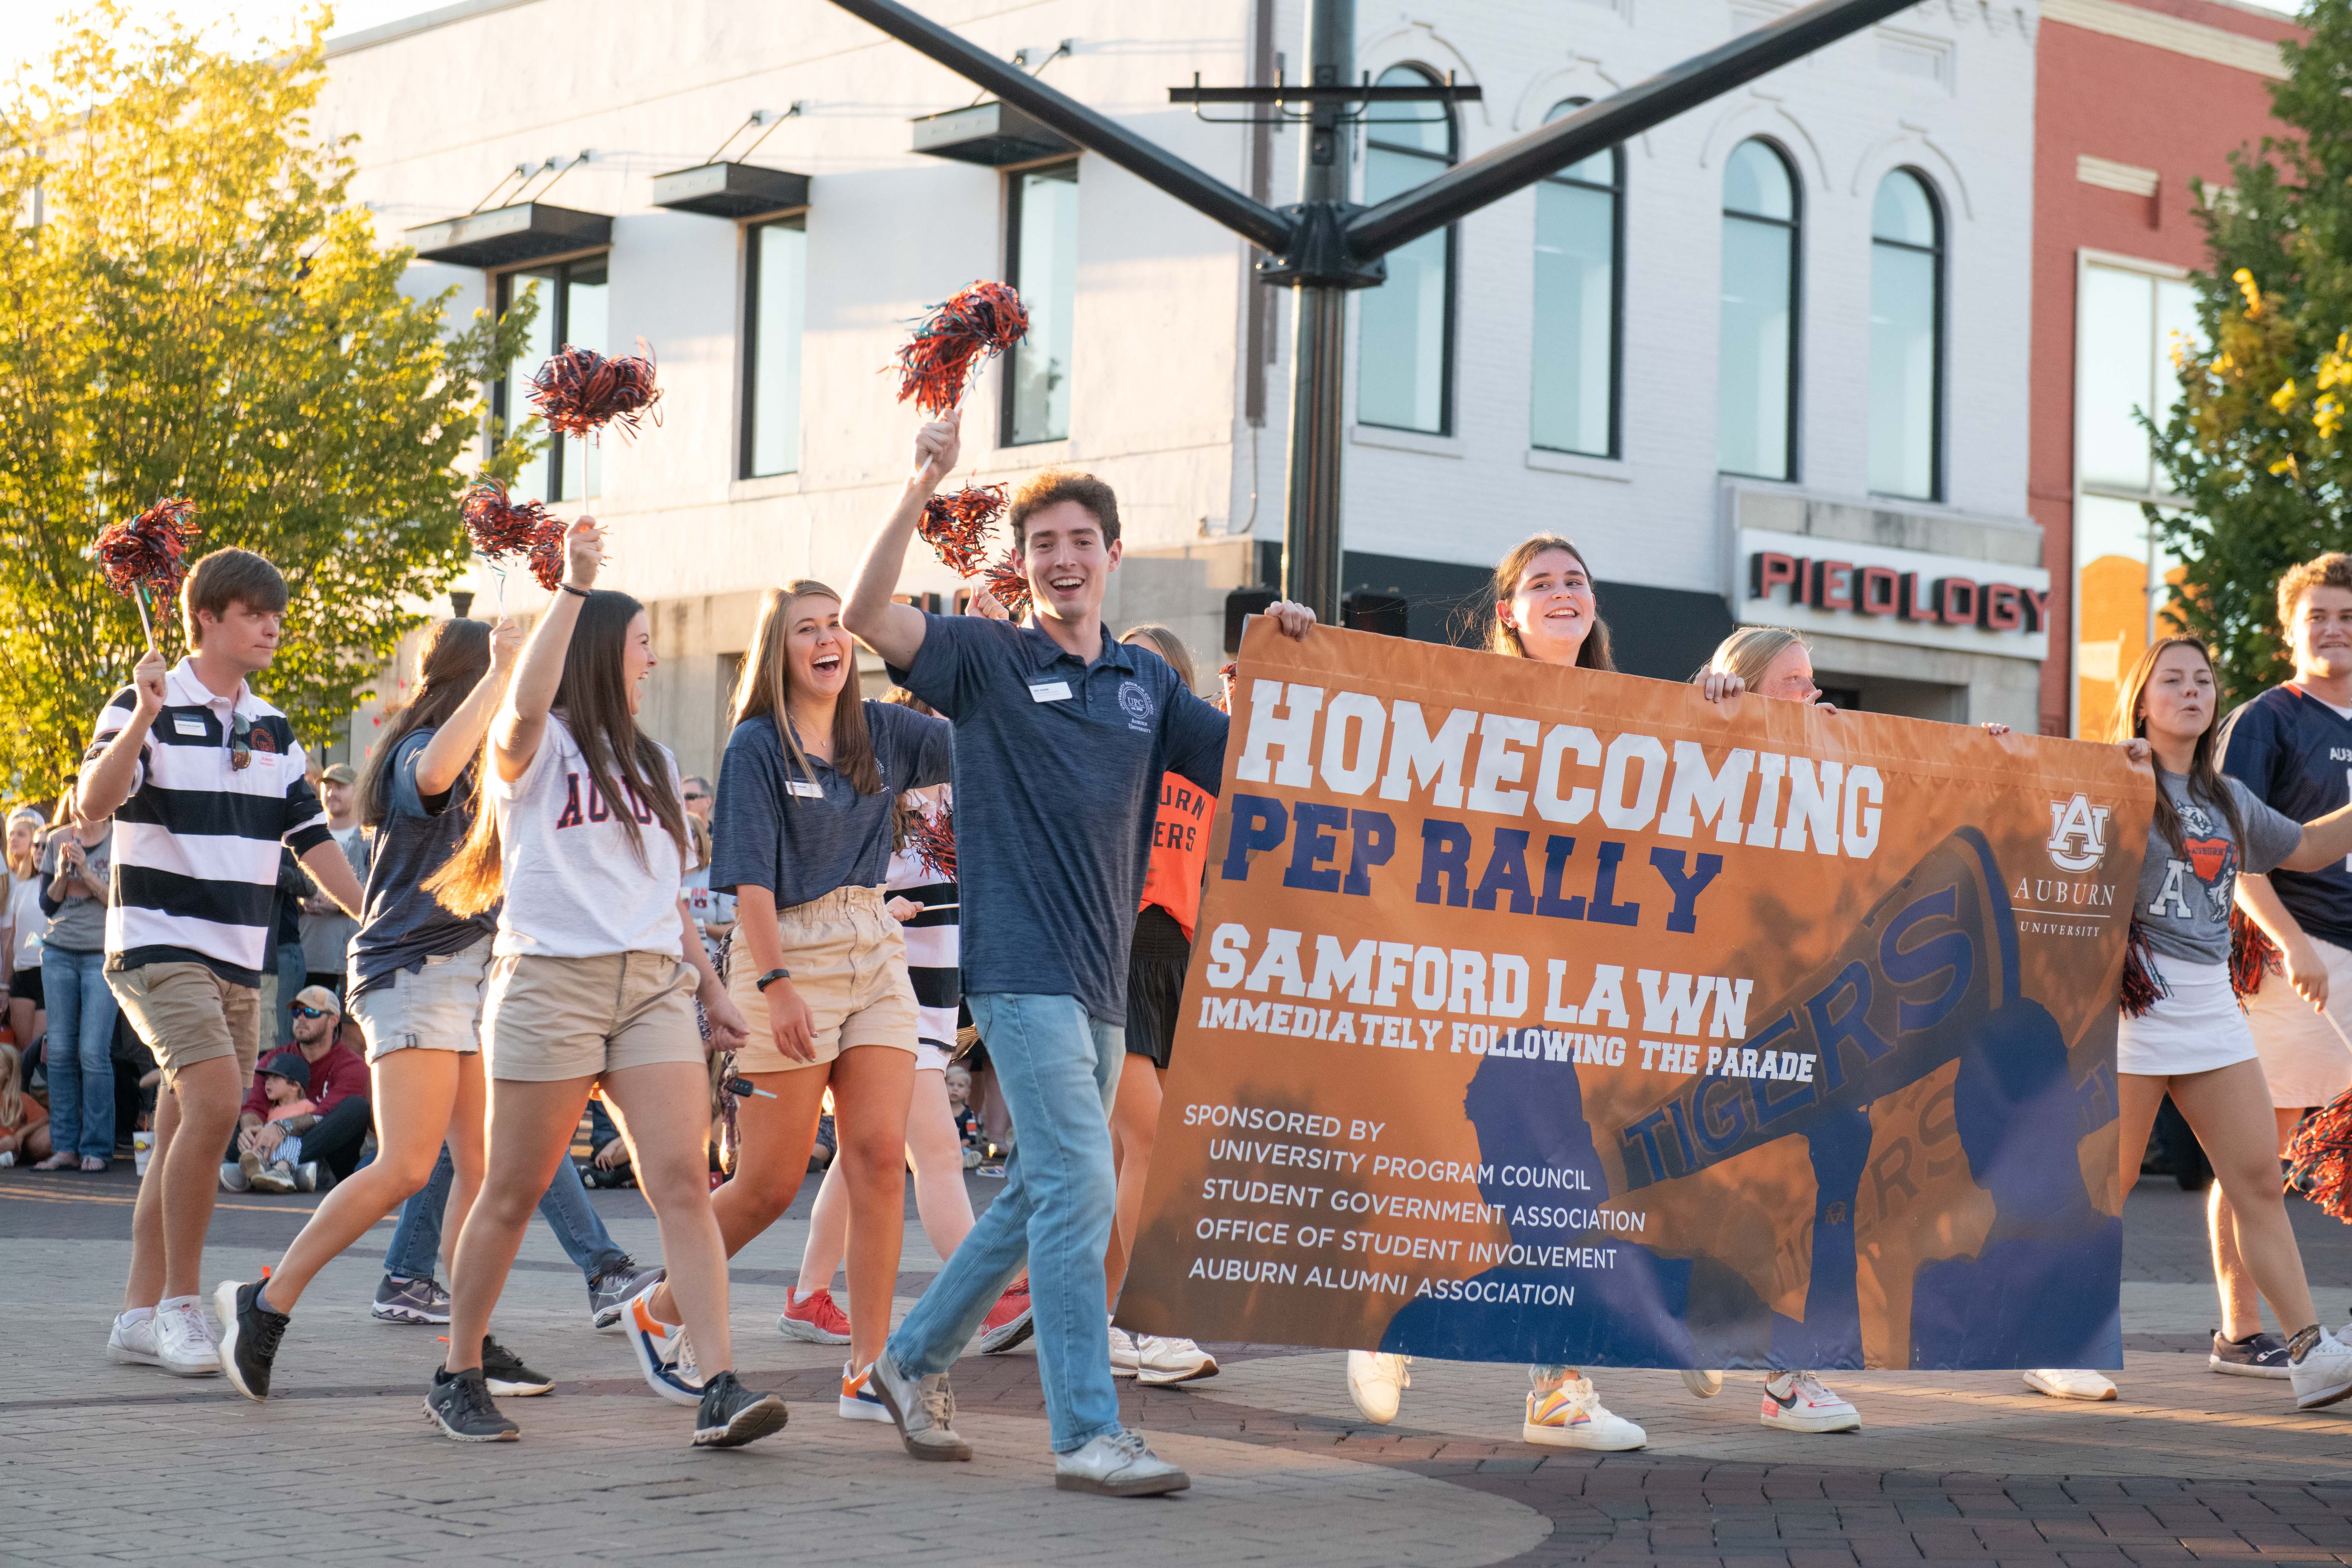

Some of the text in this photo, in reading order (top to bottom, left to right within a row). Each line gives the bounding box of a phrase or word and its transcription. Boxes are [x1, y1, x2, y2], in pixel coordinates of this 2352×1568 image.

[1751, 552, 2054, 632] PIEOLOGY
[1127, 697, 1144, 707] UPC
[875, 758, 885, 774] OUNCIL
[1236, 679, 1884, 858] HOMECOMING
[2329, 747, 2352, 762] AUB
[1160, 785, 1206, 821] URN
[1154, 821, 1196, 852] ERS
[1221, 793, 1723, 933] PEP RALLY
[2014, 877, 2116, 906] AUBURN
[2020, 921, 2100, 937] UNIVERSITY
[1206, 923, 1753, 1039] SAMFORD LAWN
[1198, 997, 1817, 1082] IMMEDIATELY FOLLOWING THE PARADE
[1624, 883, 1976, 1183] TIGERS
[1183, 1104, 1385, 1142] SPONSORED BY
[1210, 1139, 1590, 1190] UNIVERSITY PROGRAM COUNCIL
[1202, 1178, 1645, 1232] STUDENT GOVERNMENT ASSOCIATION
[1196, 1218, 1617, 1269] OFFICE OF STUDENT INVOLVEMENT
[1188, 1258, 1575, 1306] AUBURN ALUMNI ASSOCIATION
